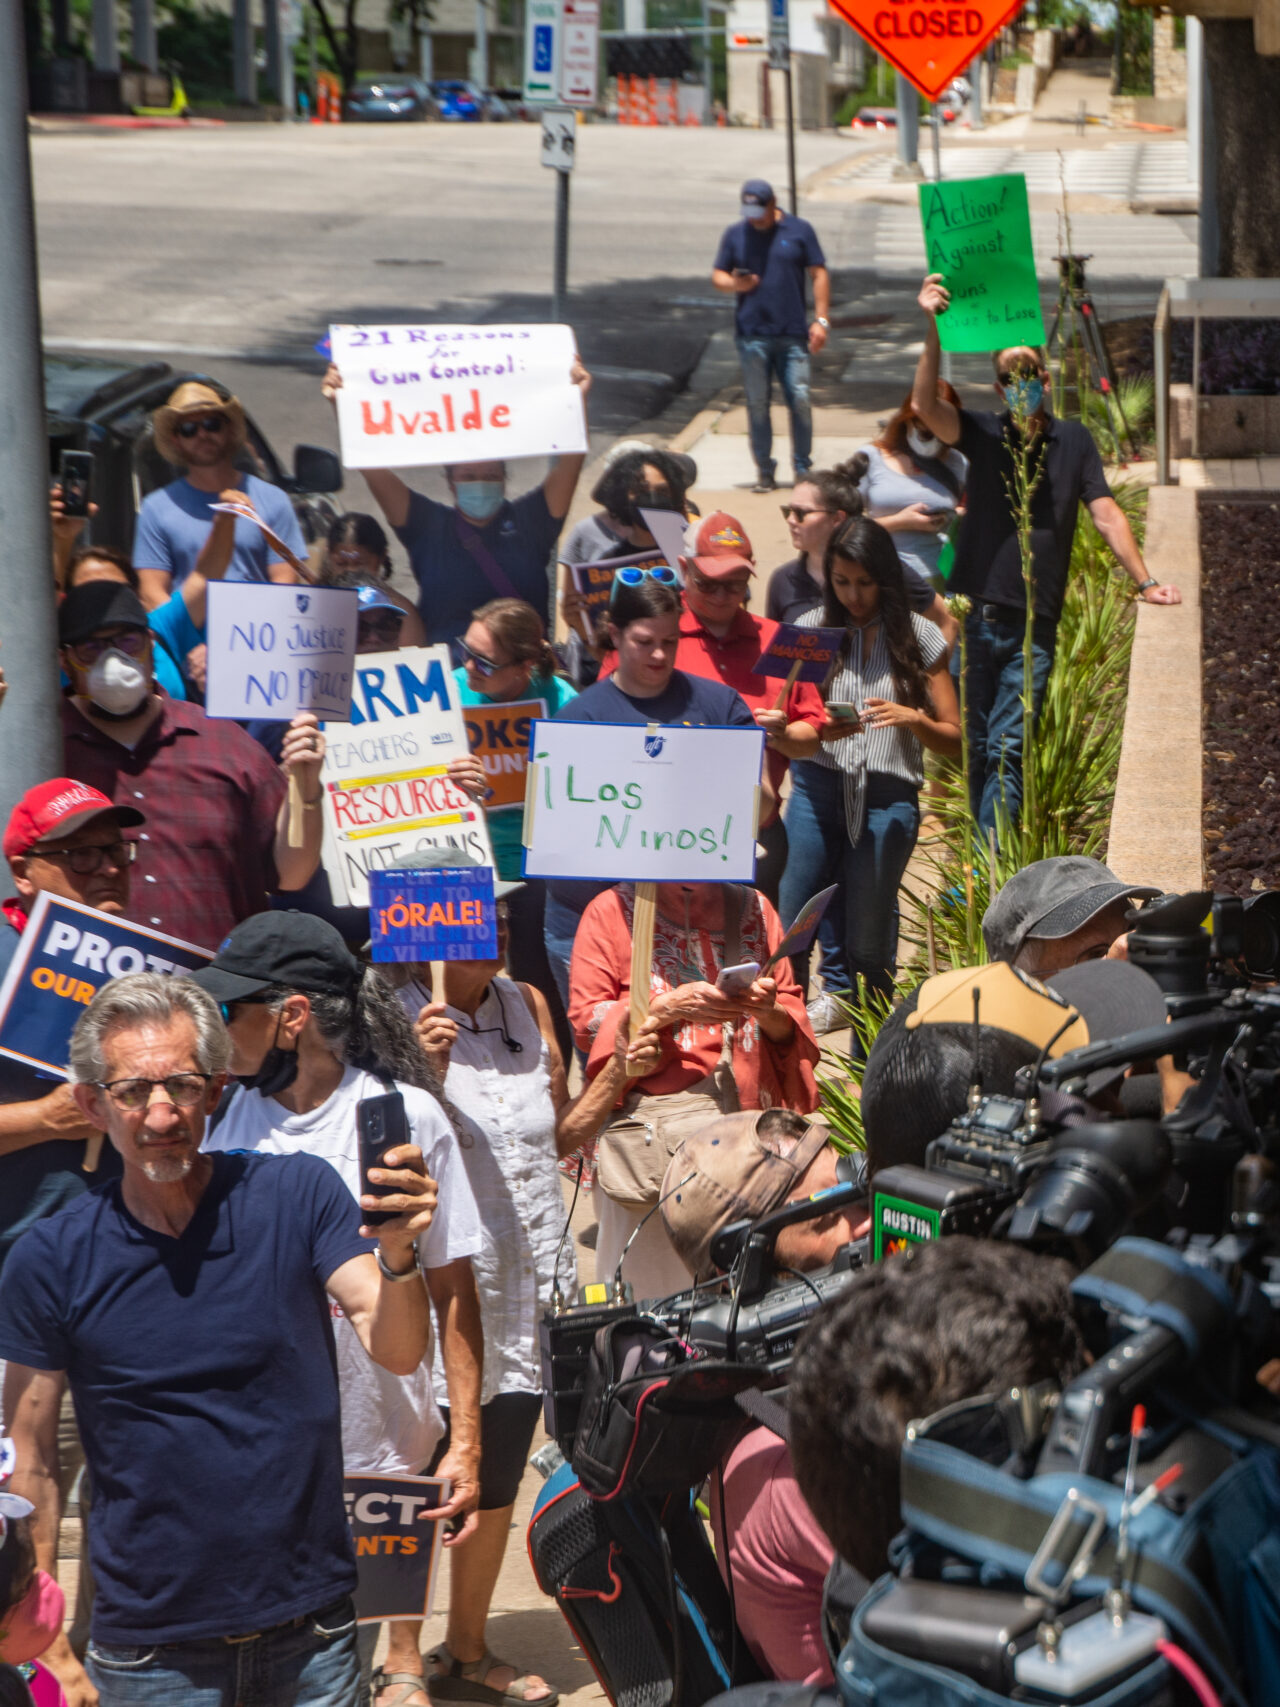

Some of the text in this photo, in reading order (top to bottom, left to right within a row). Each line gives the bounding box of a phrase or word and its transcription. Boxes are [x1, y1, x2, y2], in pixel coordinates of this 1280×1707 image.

[873, 9, 983, 39] CLOSED
[926, 185, 1008, 230] Action!
[931, 229, 1005, 270] Against
[946, 275, 988, 300] uns
[987, 308, 1000, 326] to
[1004, 303, 1037, 323] Lose
[348, 328, 531, 347] 21 Reasons
[427, 343, 460, 359] for
[369, 367, 421, 385] Gun
[360, 388, 511, 435] Uvalde
[228, 621, 346, 652] NO Justice
[796, 633, 819, 648] NO
[769, 643, 833, 663] MANCHES
[244, 669, 289, 707] NO
[325, 731, 420, 771] TEACHERS
[482, 752, 529, 776] UN
[331, 776, 470, 829] RESOURCES
[379, 894, 484, 935] ¡ÓRALE!
[43, 920, 193, 981] PROT
[30, 967, 97, 1006] OUR
[883, 1207, 931, 1240] AUSTIN
